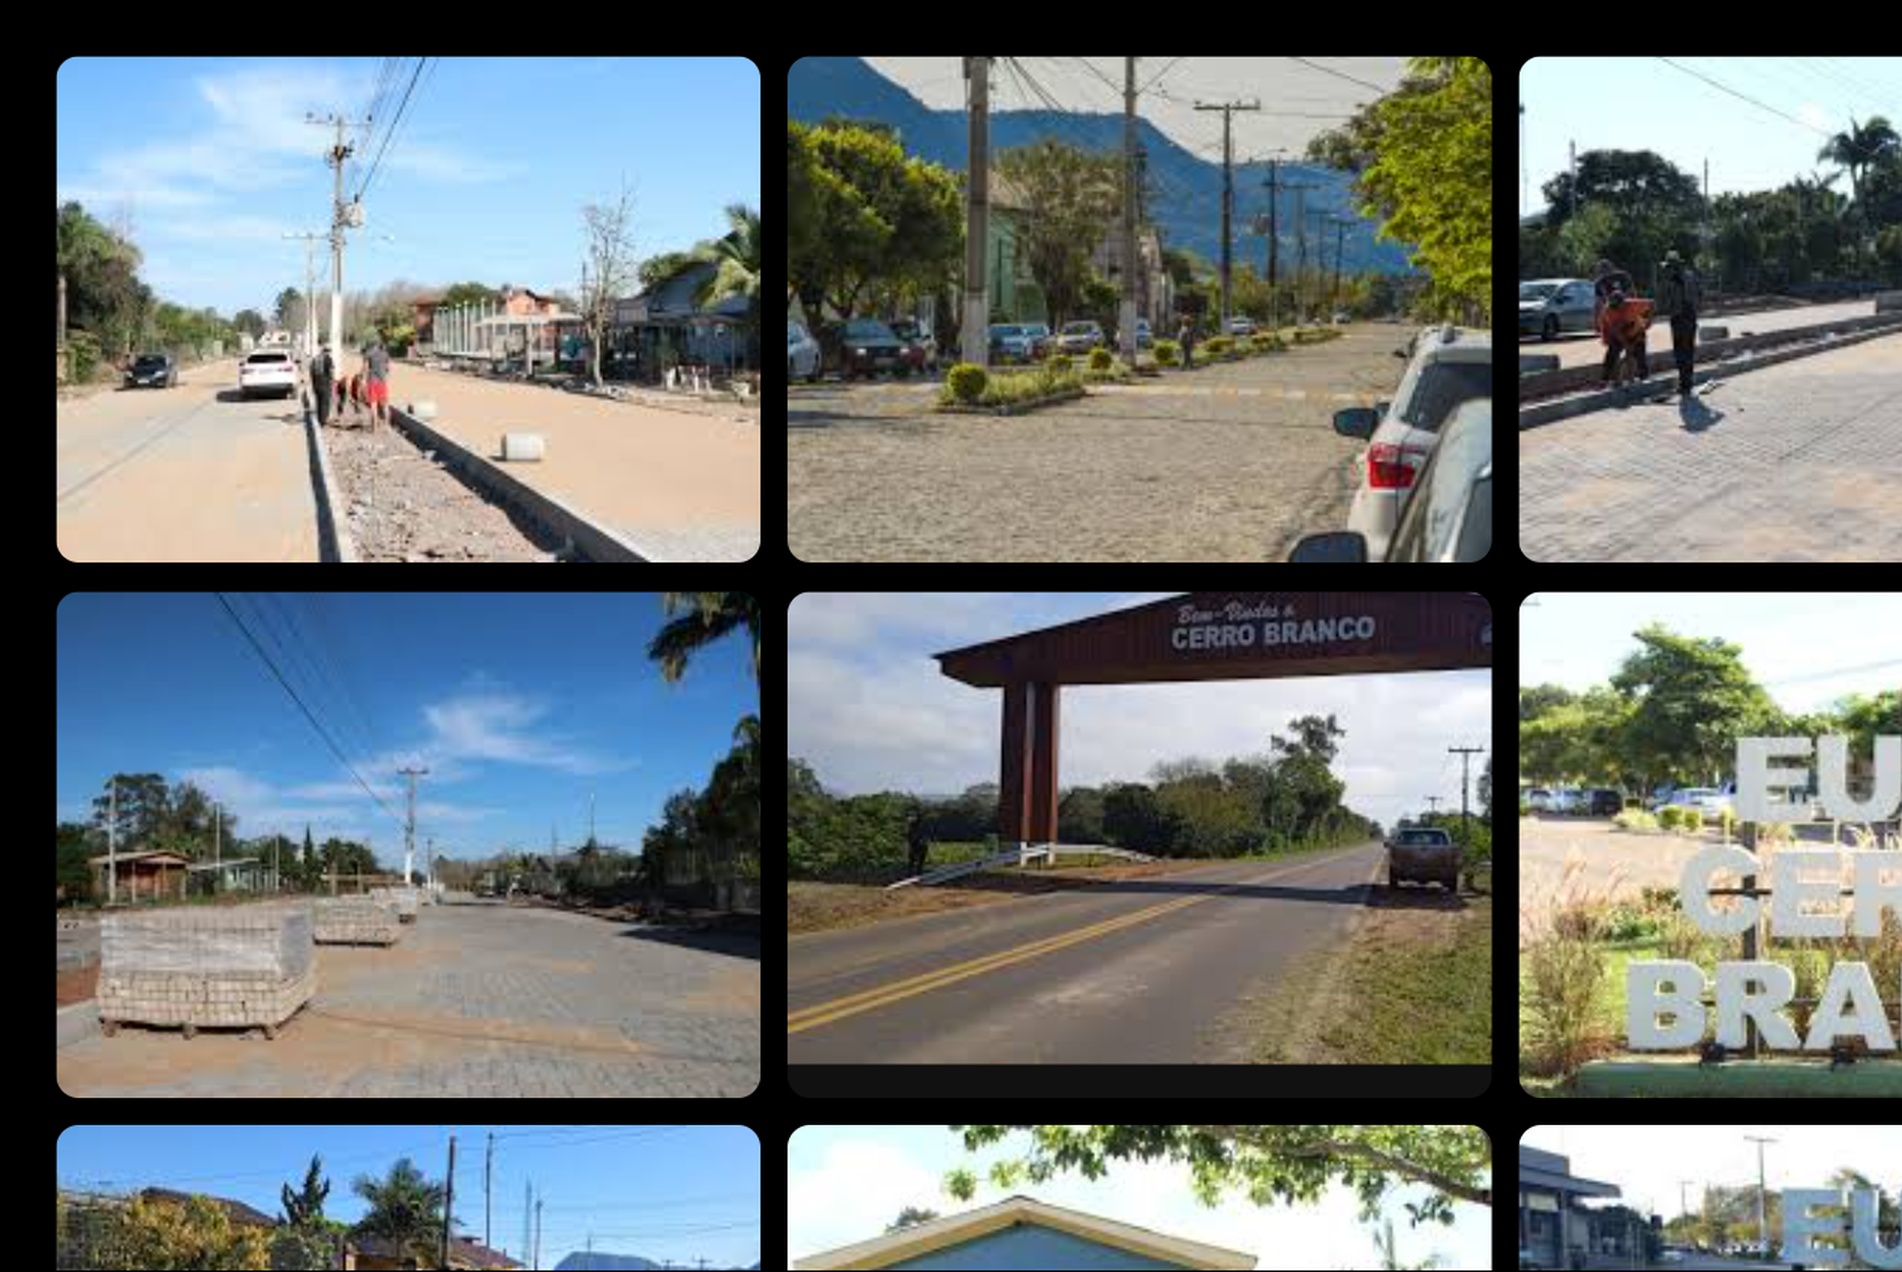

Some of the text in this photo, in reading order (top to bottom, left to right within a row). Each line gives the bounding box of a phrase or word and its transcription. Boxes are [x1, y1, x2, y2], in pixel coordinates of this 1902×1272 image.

[1172, 617, 1375, 649] CERRO BRANCO
[1736, 735, 1902, 823] EU
[1626, 959, 1898, 1050] BRA
